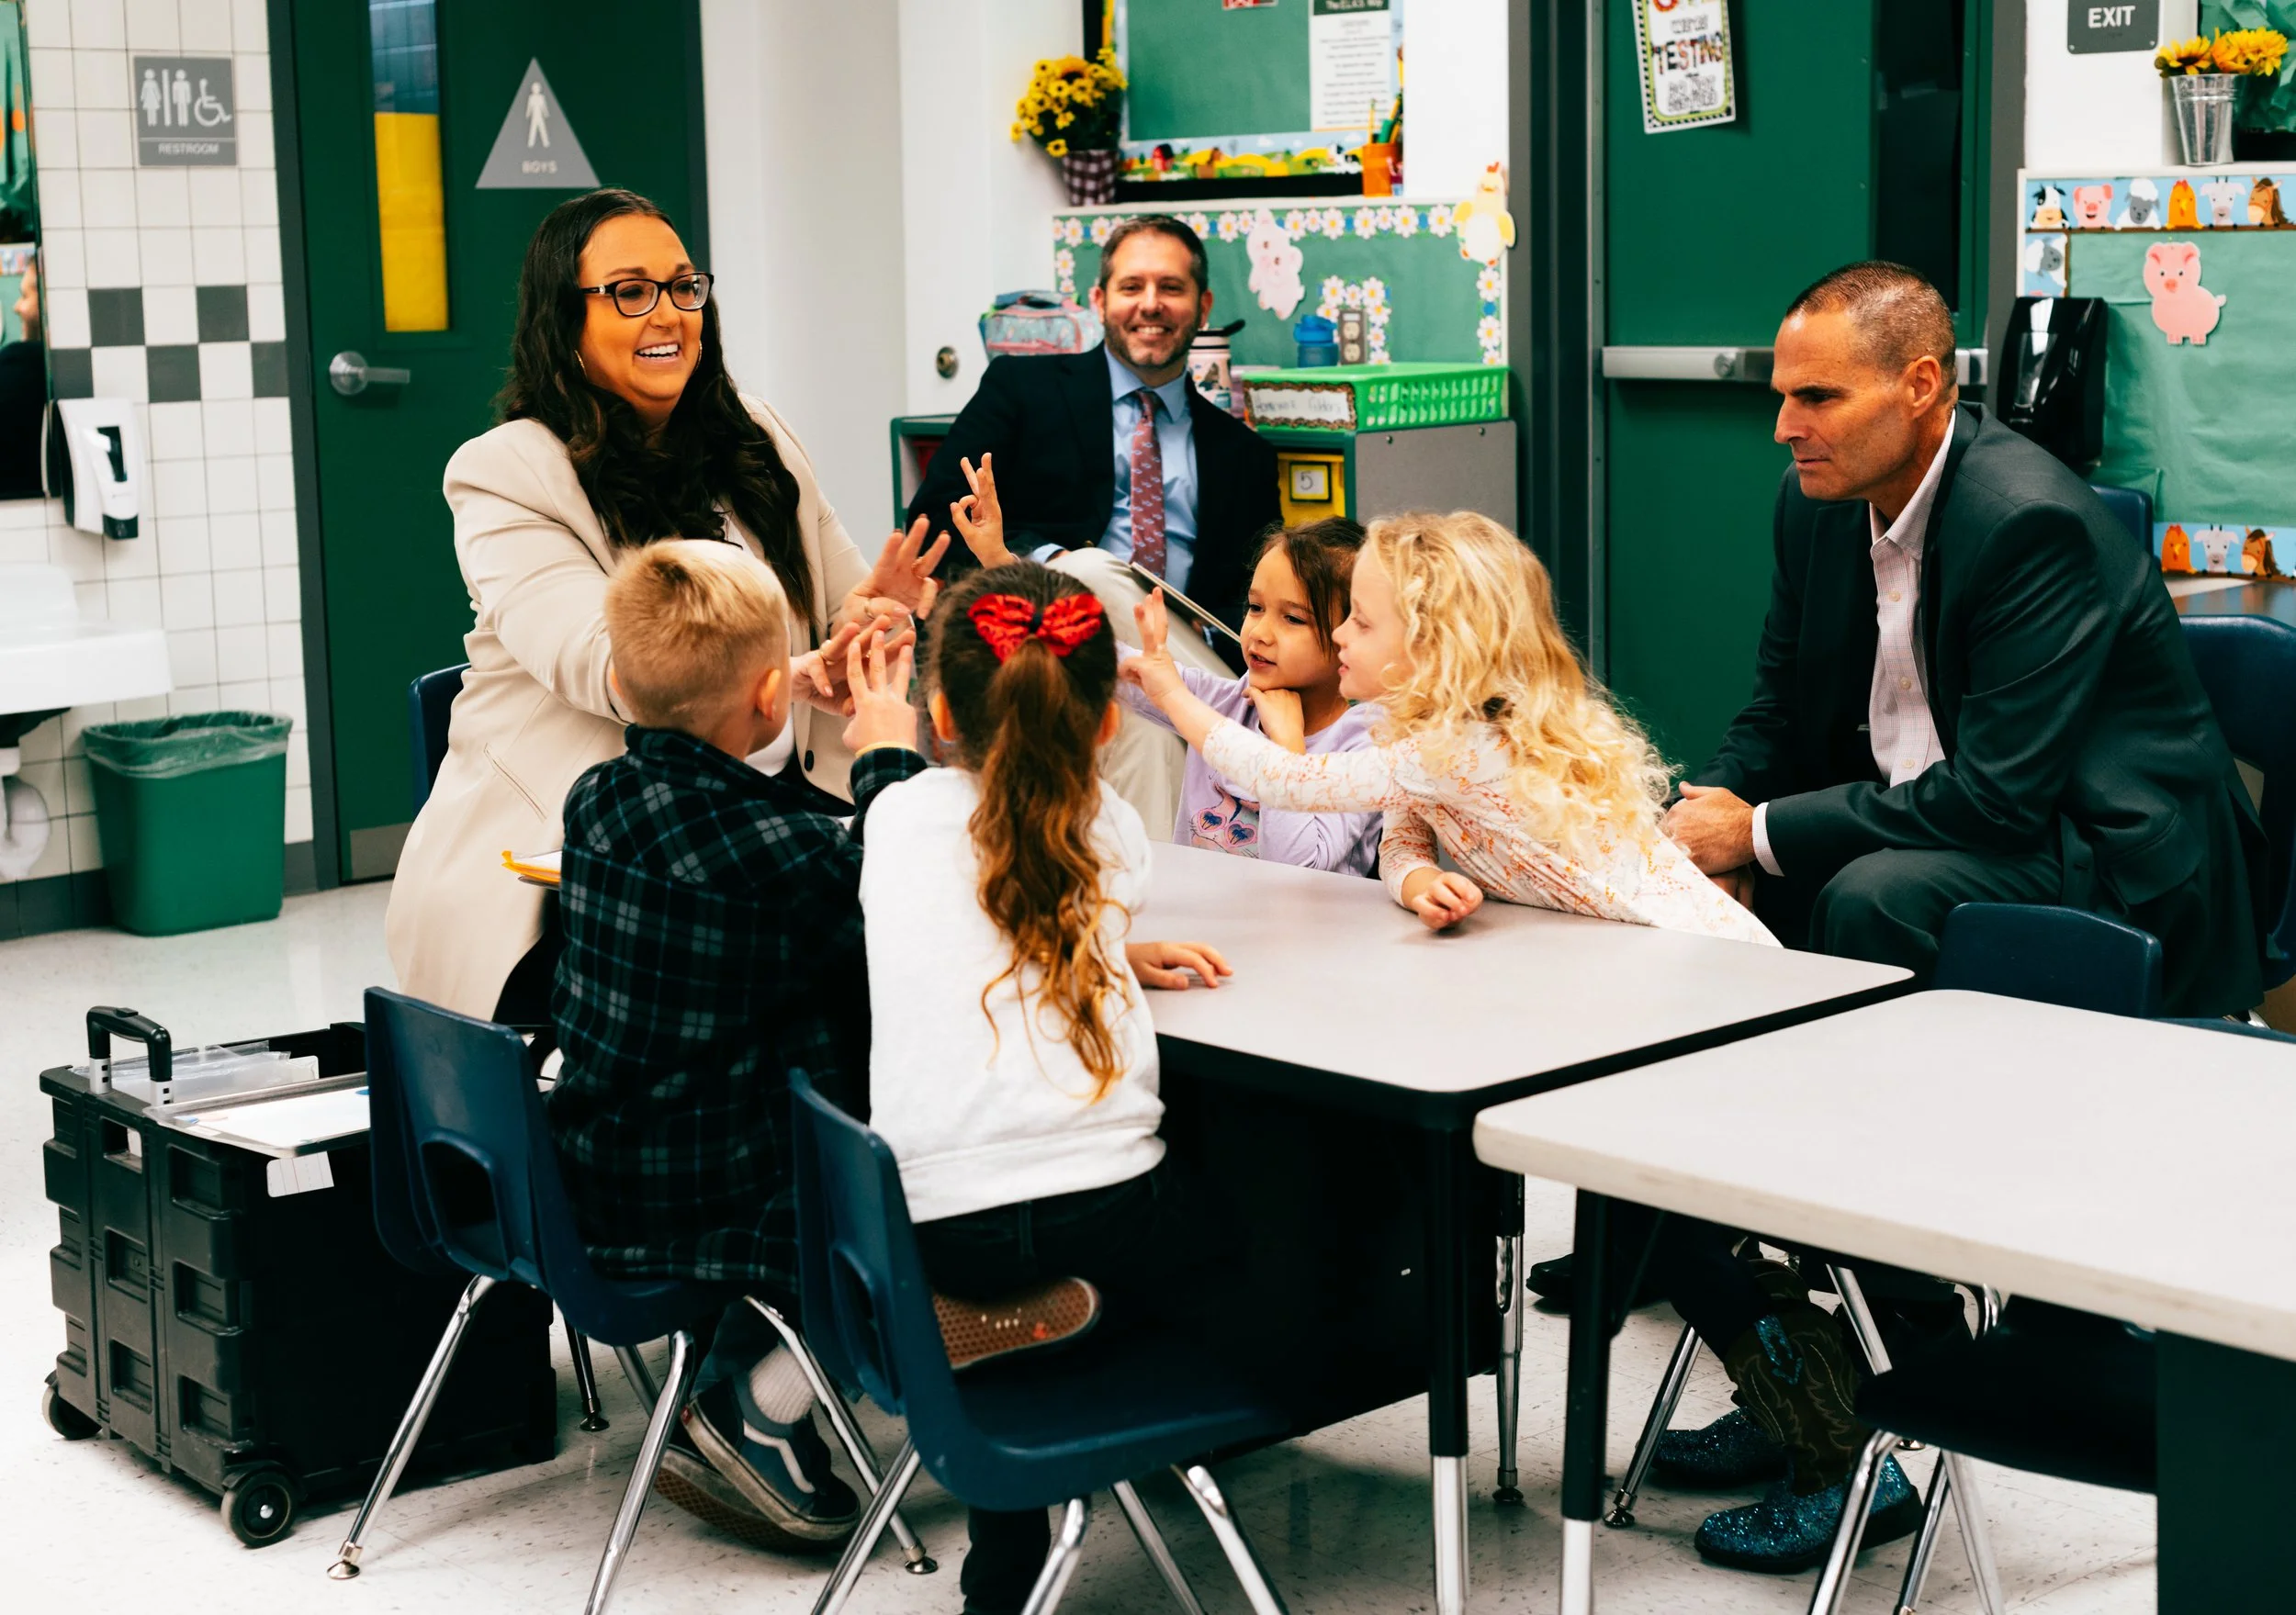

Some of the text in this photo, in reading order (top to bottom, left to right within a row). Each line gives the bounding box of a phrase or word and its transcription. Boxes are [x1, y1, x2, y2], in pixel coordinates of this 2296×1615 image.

[2088, 6, 2136, 28] EXIT
[1651, 31, 1723, 75] TESTING
[158, 142, 219, 155] RESTROOM
[522, 160, 557, 174] BOYS
[1300, 470, 1313, 490] 5
